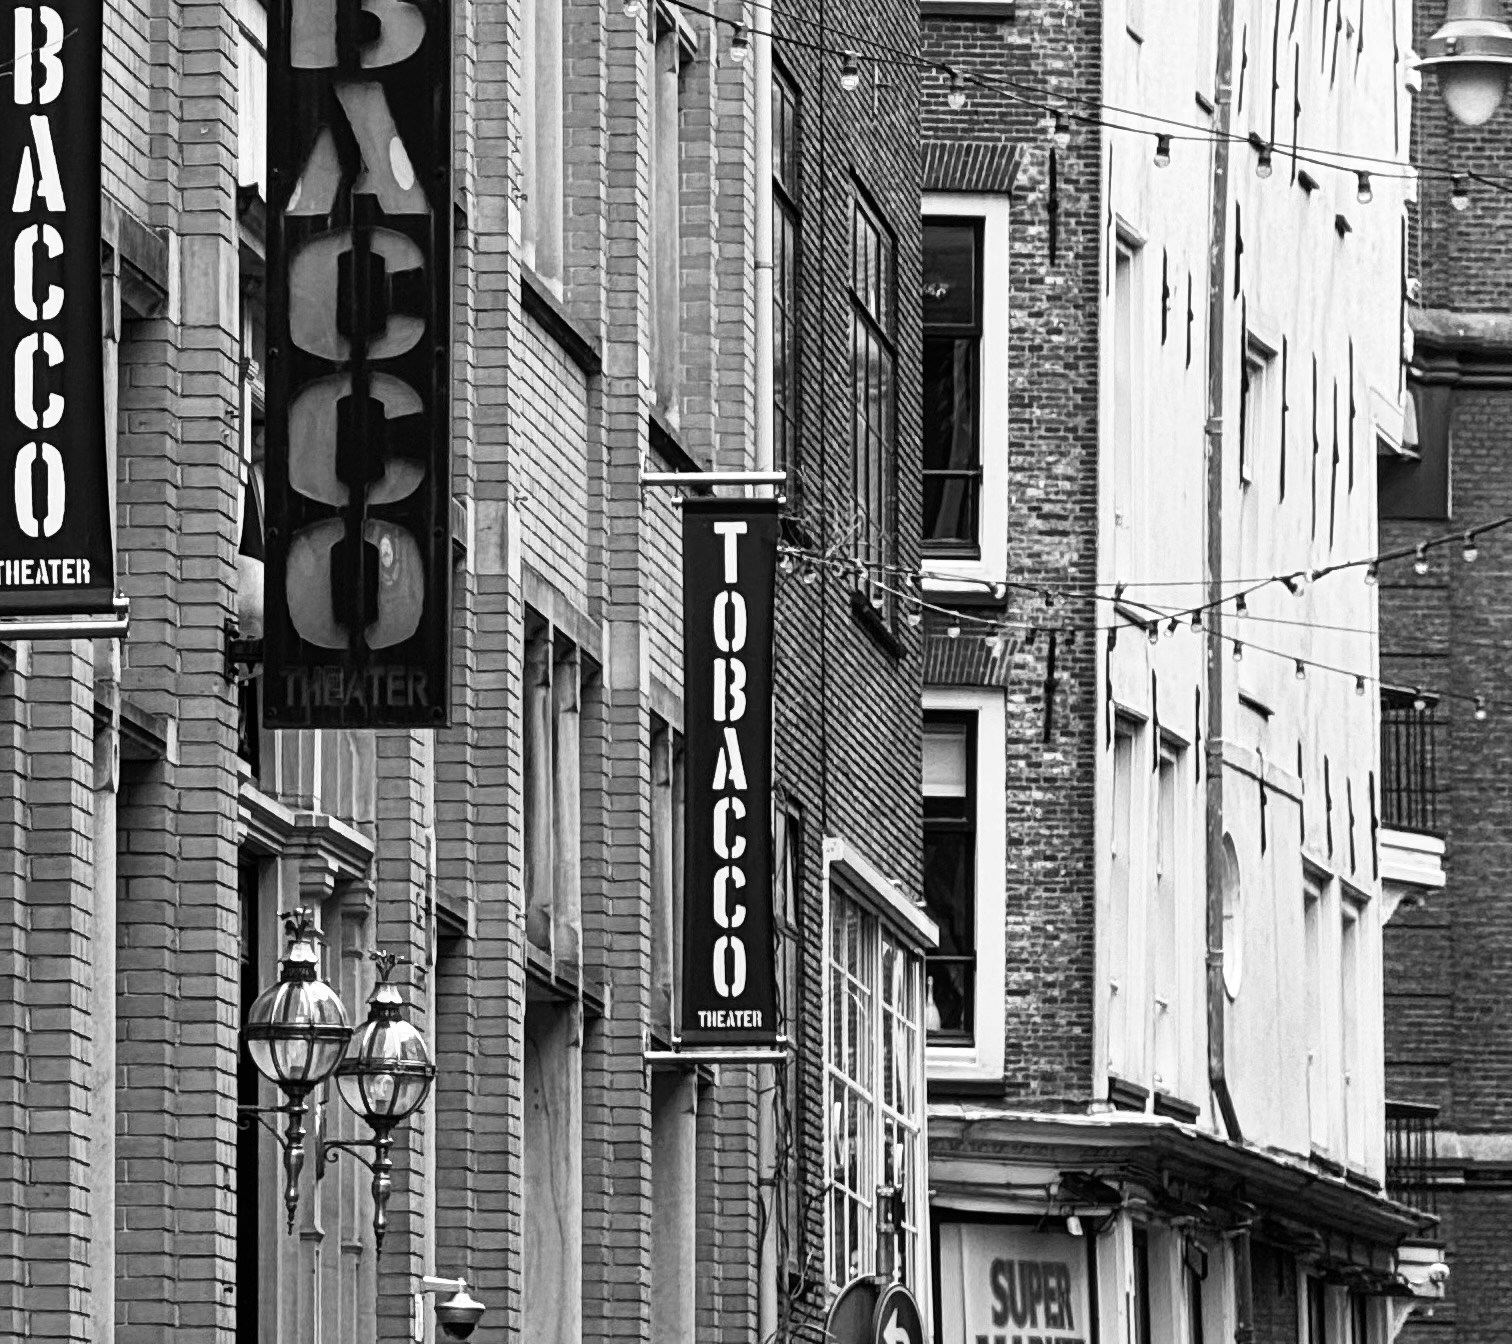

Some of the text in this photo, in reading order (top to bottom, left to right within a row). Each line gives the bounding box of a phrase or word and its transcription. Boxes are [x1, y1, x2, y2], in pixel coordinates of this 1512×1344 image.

[279, 665, 429, 706] THEATER
[712, 521, 748, 998] TOBACCO
[697, 1010, 762, 1028] THEATER
[990, 1257, 1075, 1331] SUPER
